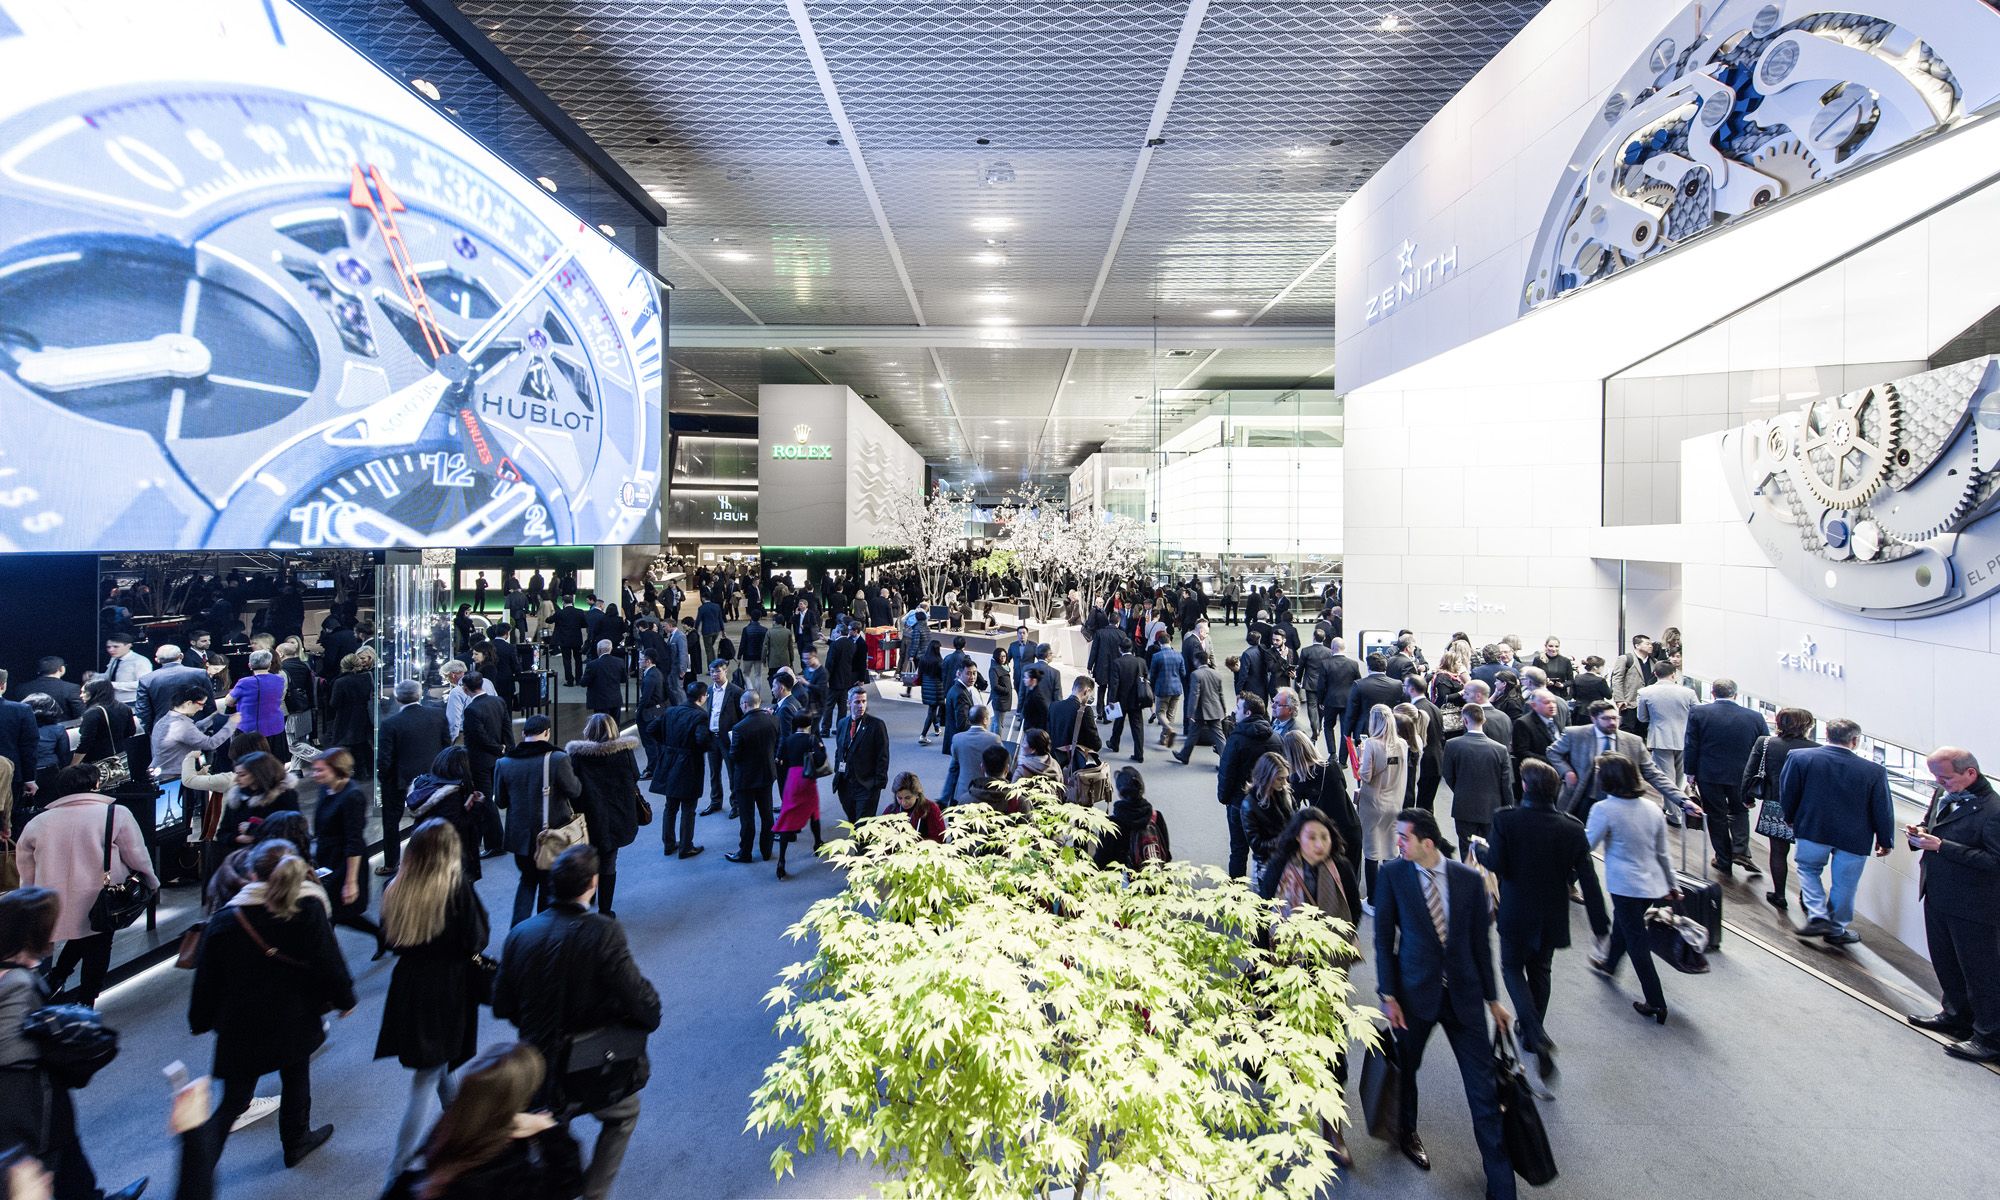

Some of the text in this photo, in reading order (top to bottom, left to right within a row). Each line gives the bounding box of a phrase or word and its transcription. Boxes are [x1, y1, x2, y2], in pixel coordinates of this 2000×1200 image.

[1366, 245, 1458, 320] ZENITH
[482, 392, 594, 432] HUBLOT
[460, 408, 493, 466] MINUTES
[772, 445, 833, 460] ROLEX
[426, 452, 475, 487] 12
[523, 504, 548, 536] 2
[1967, 569, 1986, 586] EL
[1439, 602, 1506, 614] ZENITH
[1776, 651, 1843, 678] ZENITH
